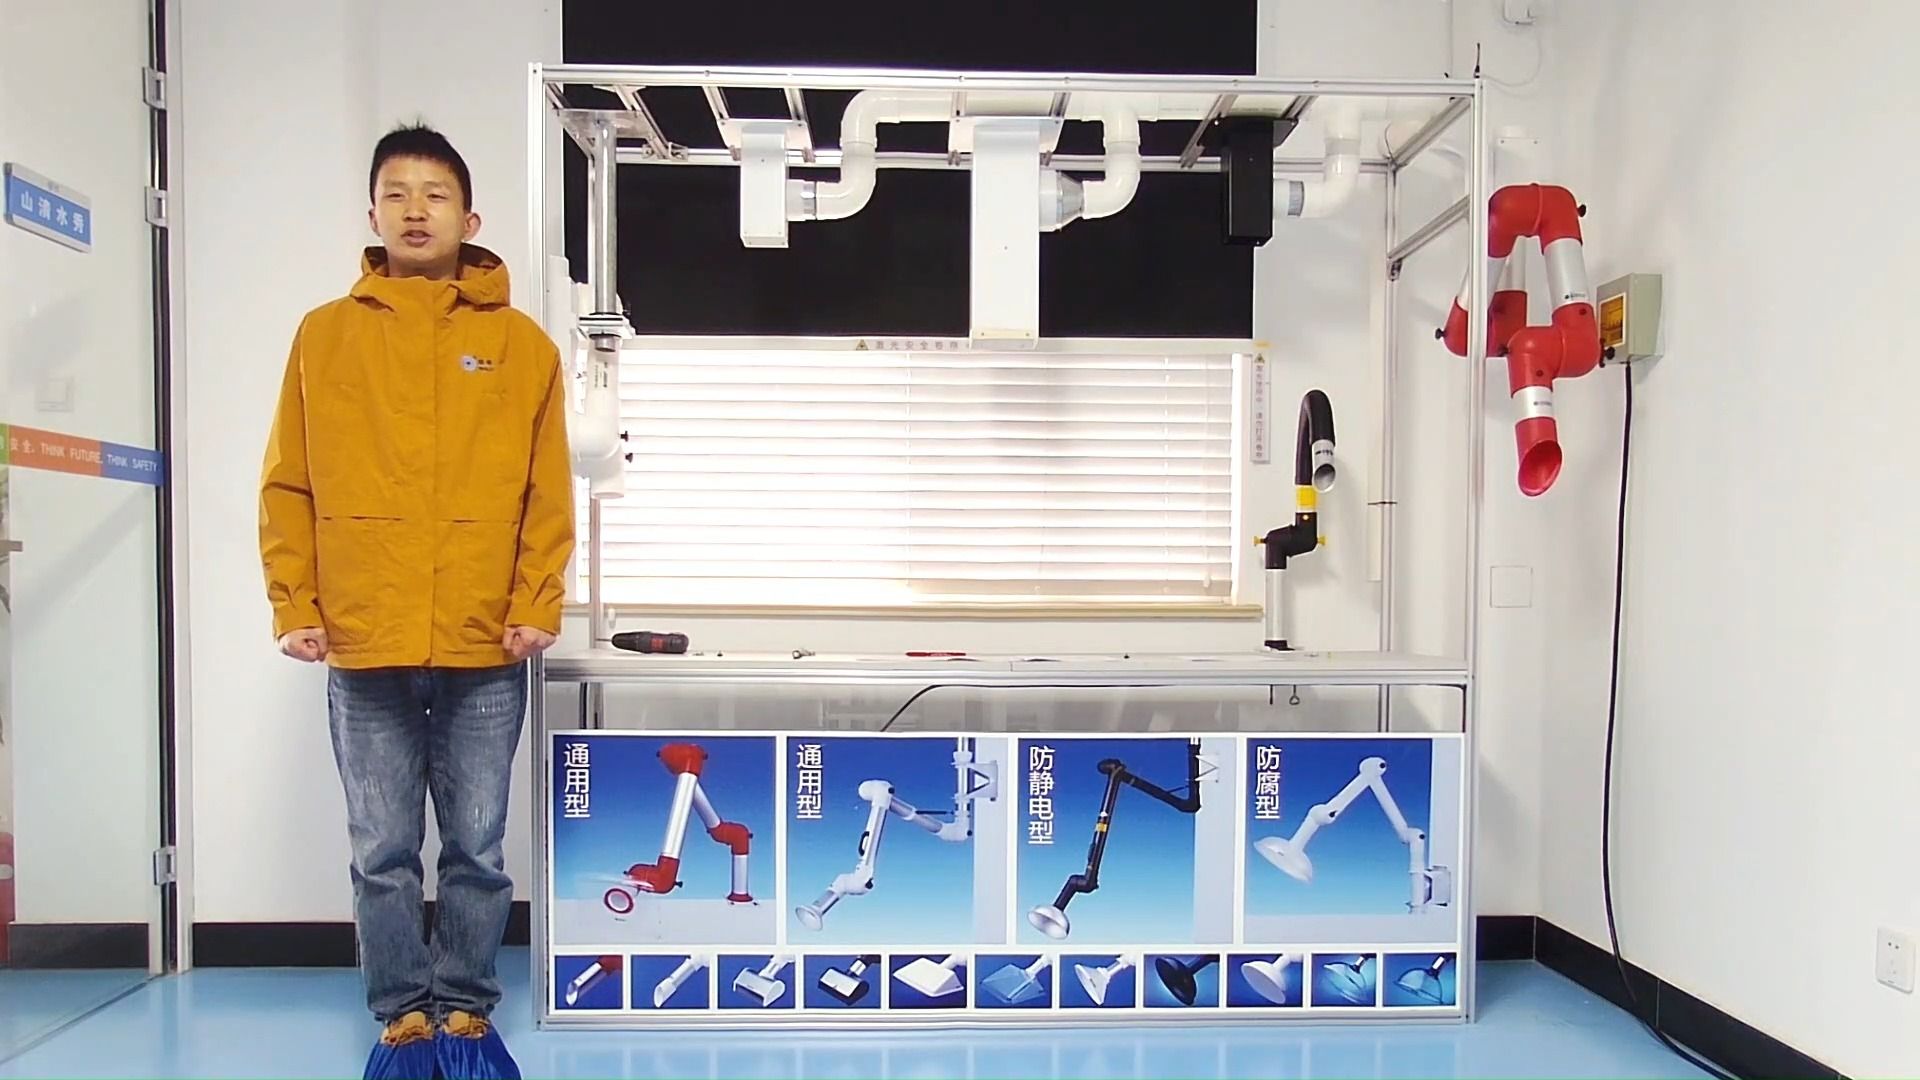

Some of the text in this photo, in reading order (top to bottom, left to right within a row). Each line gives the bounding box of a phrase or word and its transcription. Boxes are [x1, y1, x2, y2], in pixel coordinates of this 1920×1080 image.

[41, 442, 65, 458] THINK
[107, 454, 129, 467] THINK
[132, 458, 158, 472] SAFETY
[563, 743, 591, 818] 通用型
[796, 744, 823, 819] 通用型
[1028, 746, 1055, 845] 防静电型
[1255, 746, 1281, 820] 防腐型
